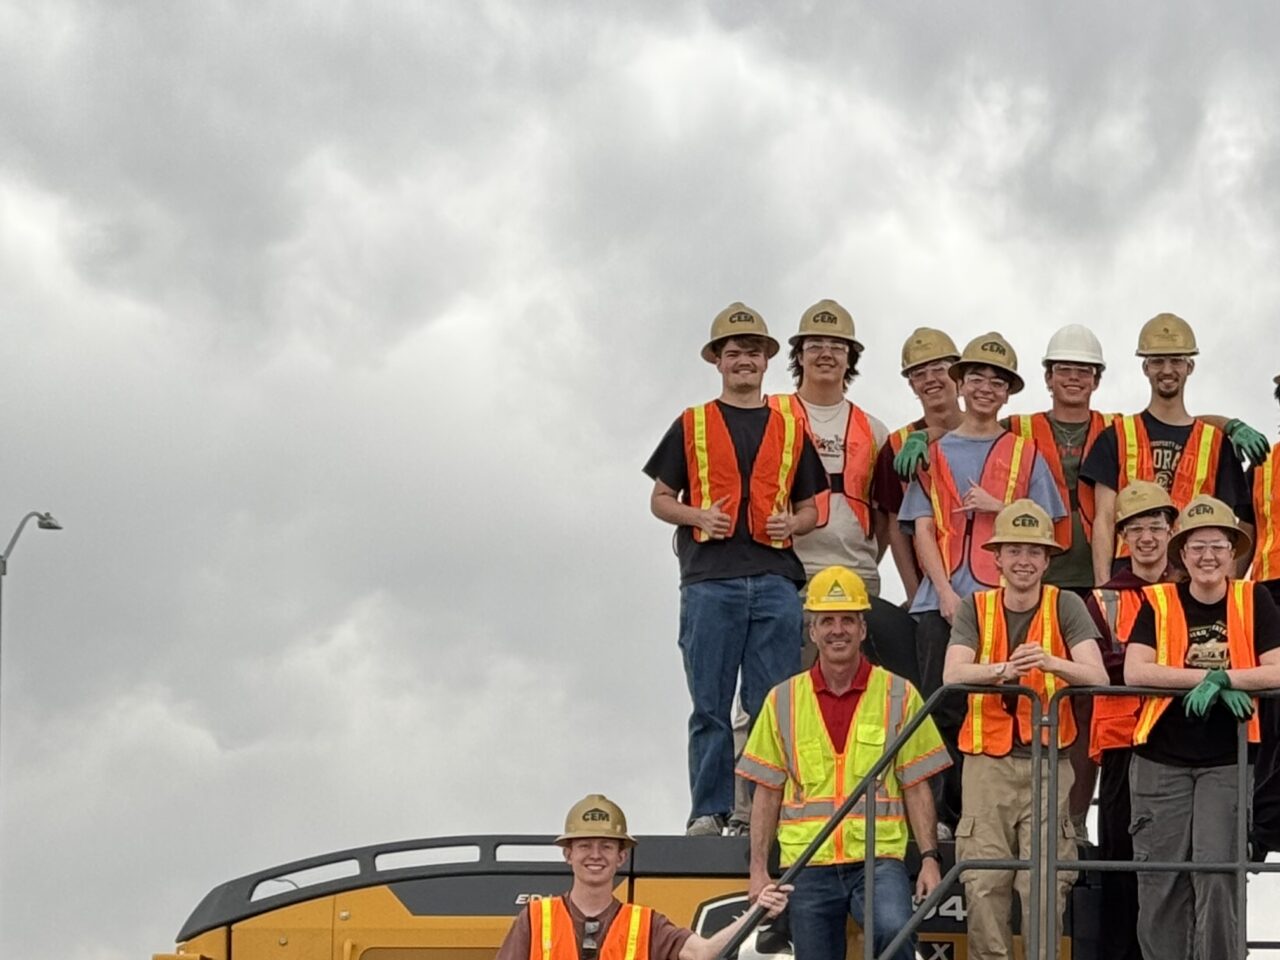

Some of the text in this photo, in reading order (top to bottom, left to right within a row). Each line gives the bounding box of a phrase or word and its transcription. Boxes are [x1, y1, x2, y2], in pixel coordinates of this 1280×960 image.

[813, 312, 838, 325] CEM
[981, 341, 1007, 356] CEM
[1188, 504, 1214, 517] CEM
[1012, 514, 1039, 528] CEM
[582, 808, 610, 822] CEM
